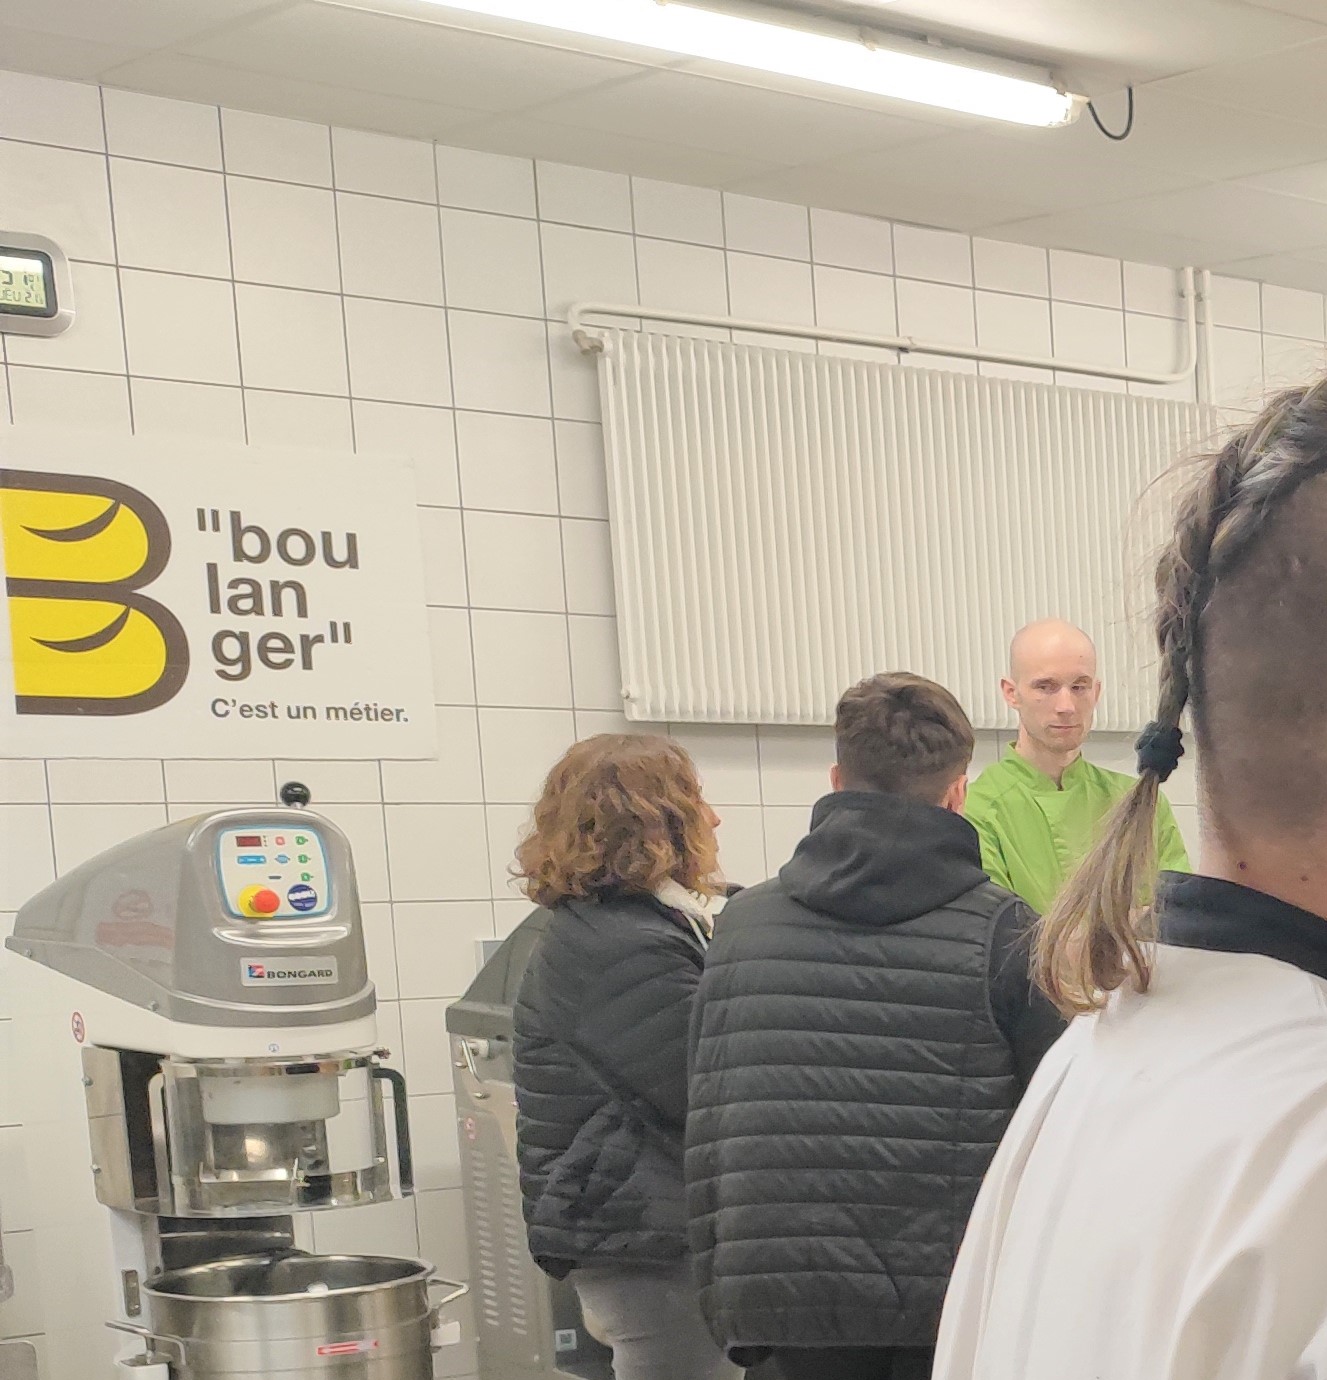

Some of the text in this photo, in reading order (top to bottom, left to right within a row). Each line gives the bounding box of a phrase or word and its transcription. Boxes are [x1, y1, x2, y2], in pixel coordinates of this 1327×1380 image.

[197, 508, 359, 569] "bou
[206, 562, 308, 618] lan
[211, 621, 352, 681] ger"
[211, 698, 409, 722] C'est un métier.
[266, 969, 333, 978] BONGARD
